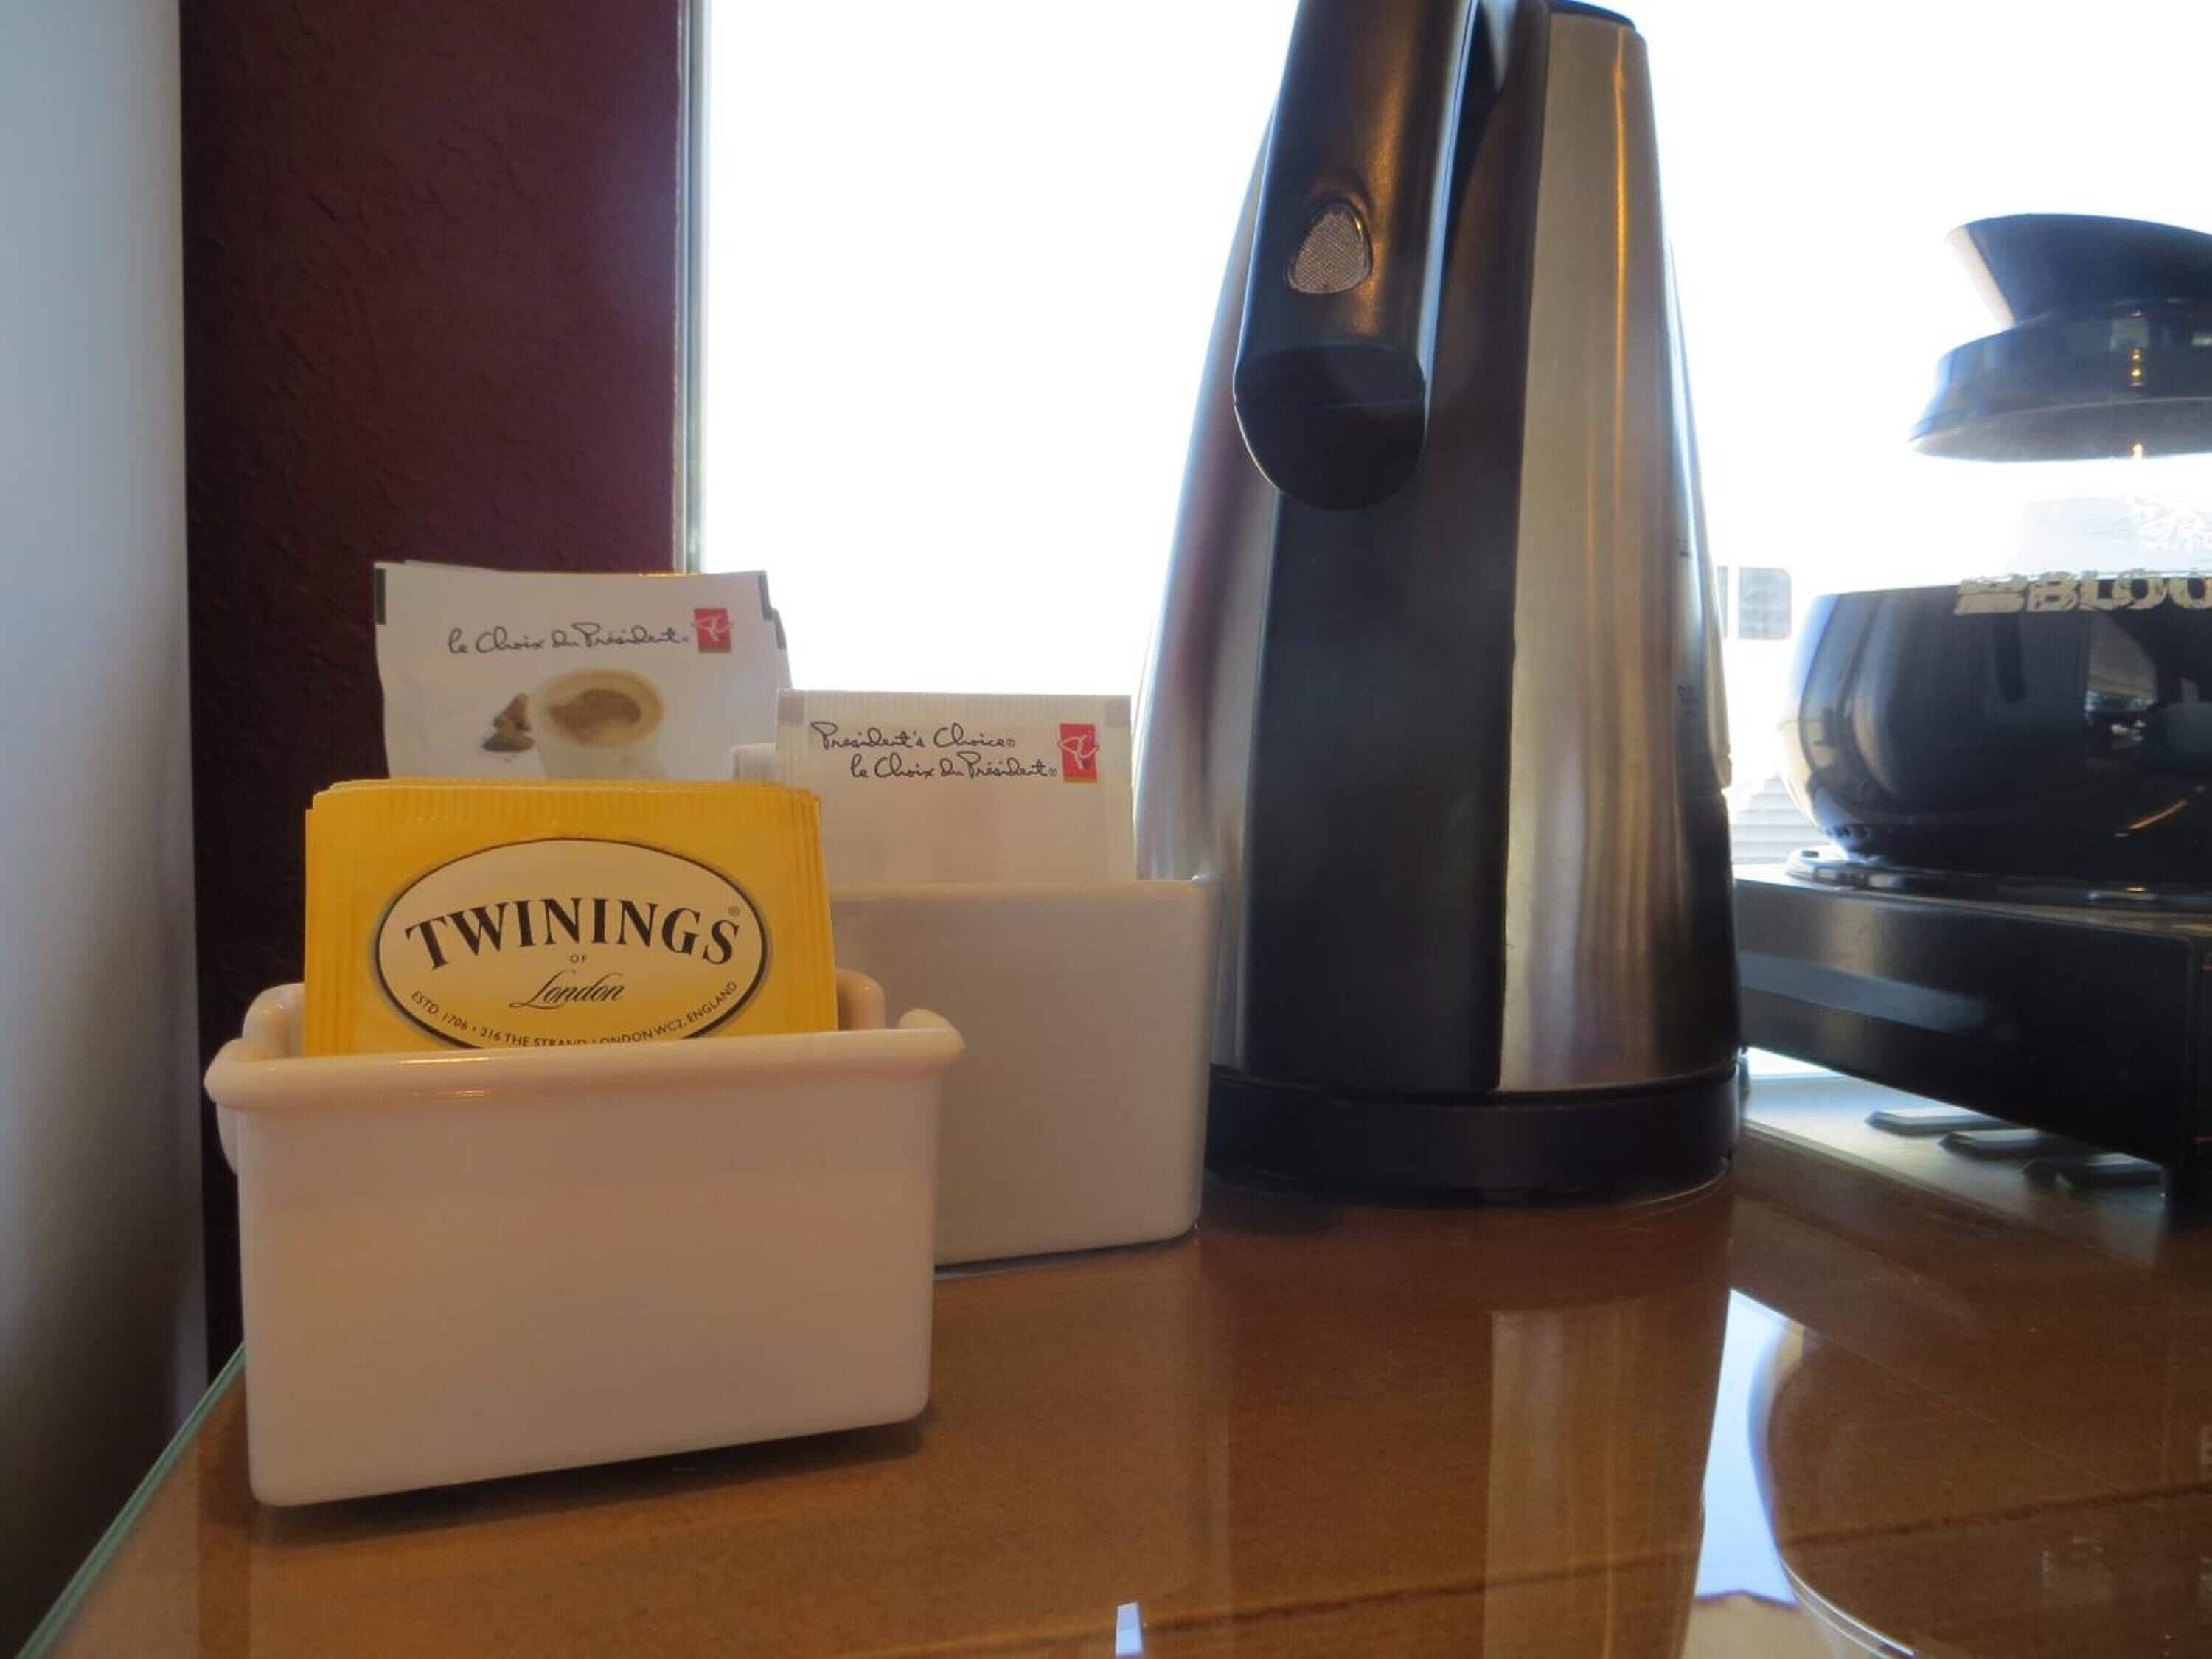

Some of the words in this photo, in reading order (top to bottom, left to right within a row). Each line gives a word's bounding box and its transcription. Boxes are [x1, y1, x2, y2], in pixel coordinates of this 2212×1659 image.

[476, 626, 545, 654] Choix
[572, 622, 682, 648] Président
[811, 722, 925, 750] President's
[933, 722, 1005, 748] Choice
[874, 752, 936, 779] Choix
[957, 751, 1048, 779] Président
[404, 897, 740, 970] TWININGS
[508, 968, 625, 1009] London
[442, 1012, 468, 1032] 1706
[506, 1033, 532, 1048] THE
[686, 981, 737, 1023] ENGLAND
